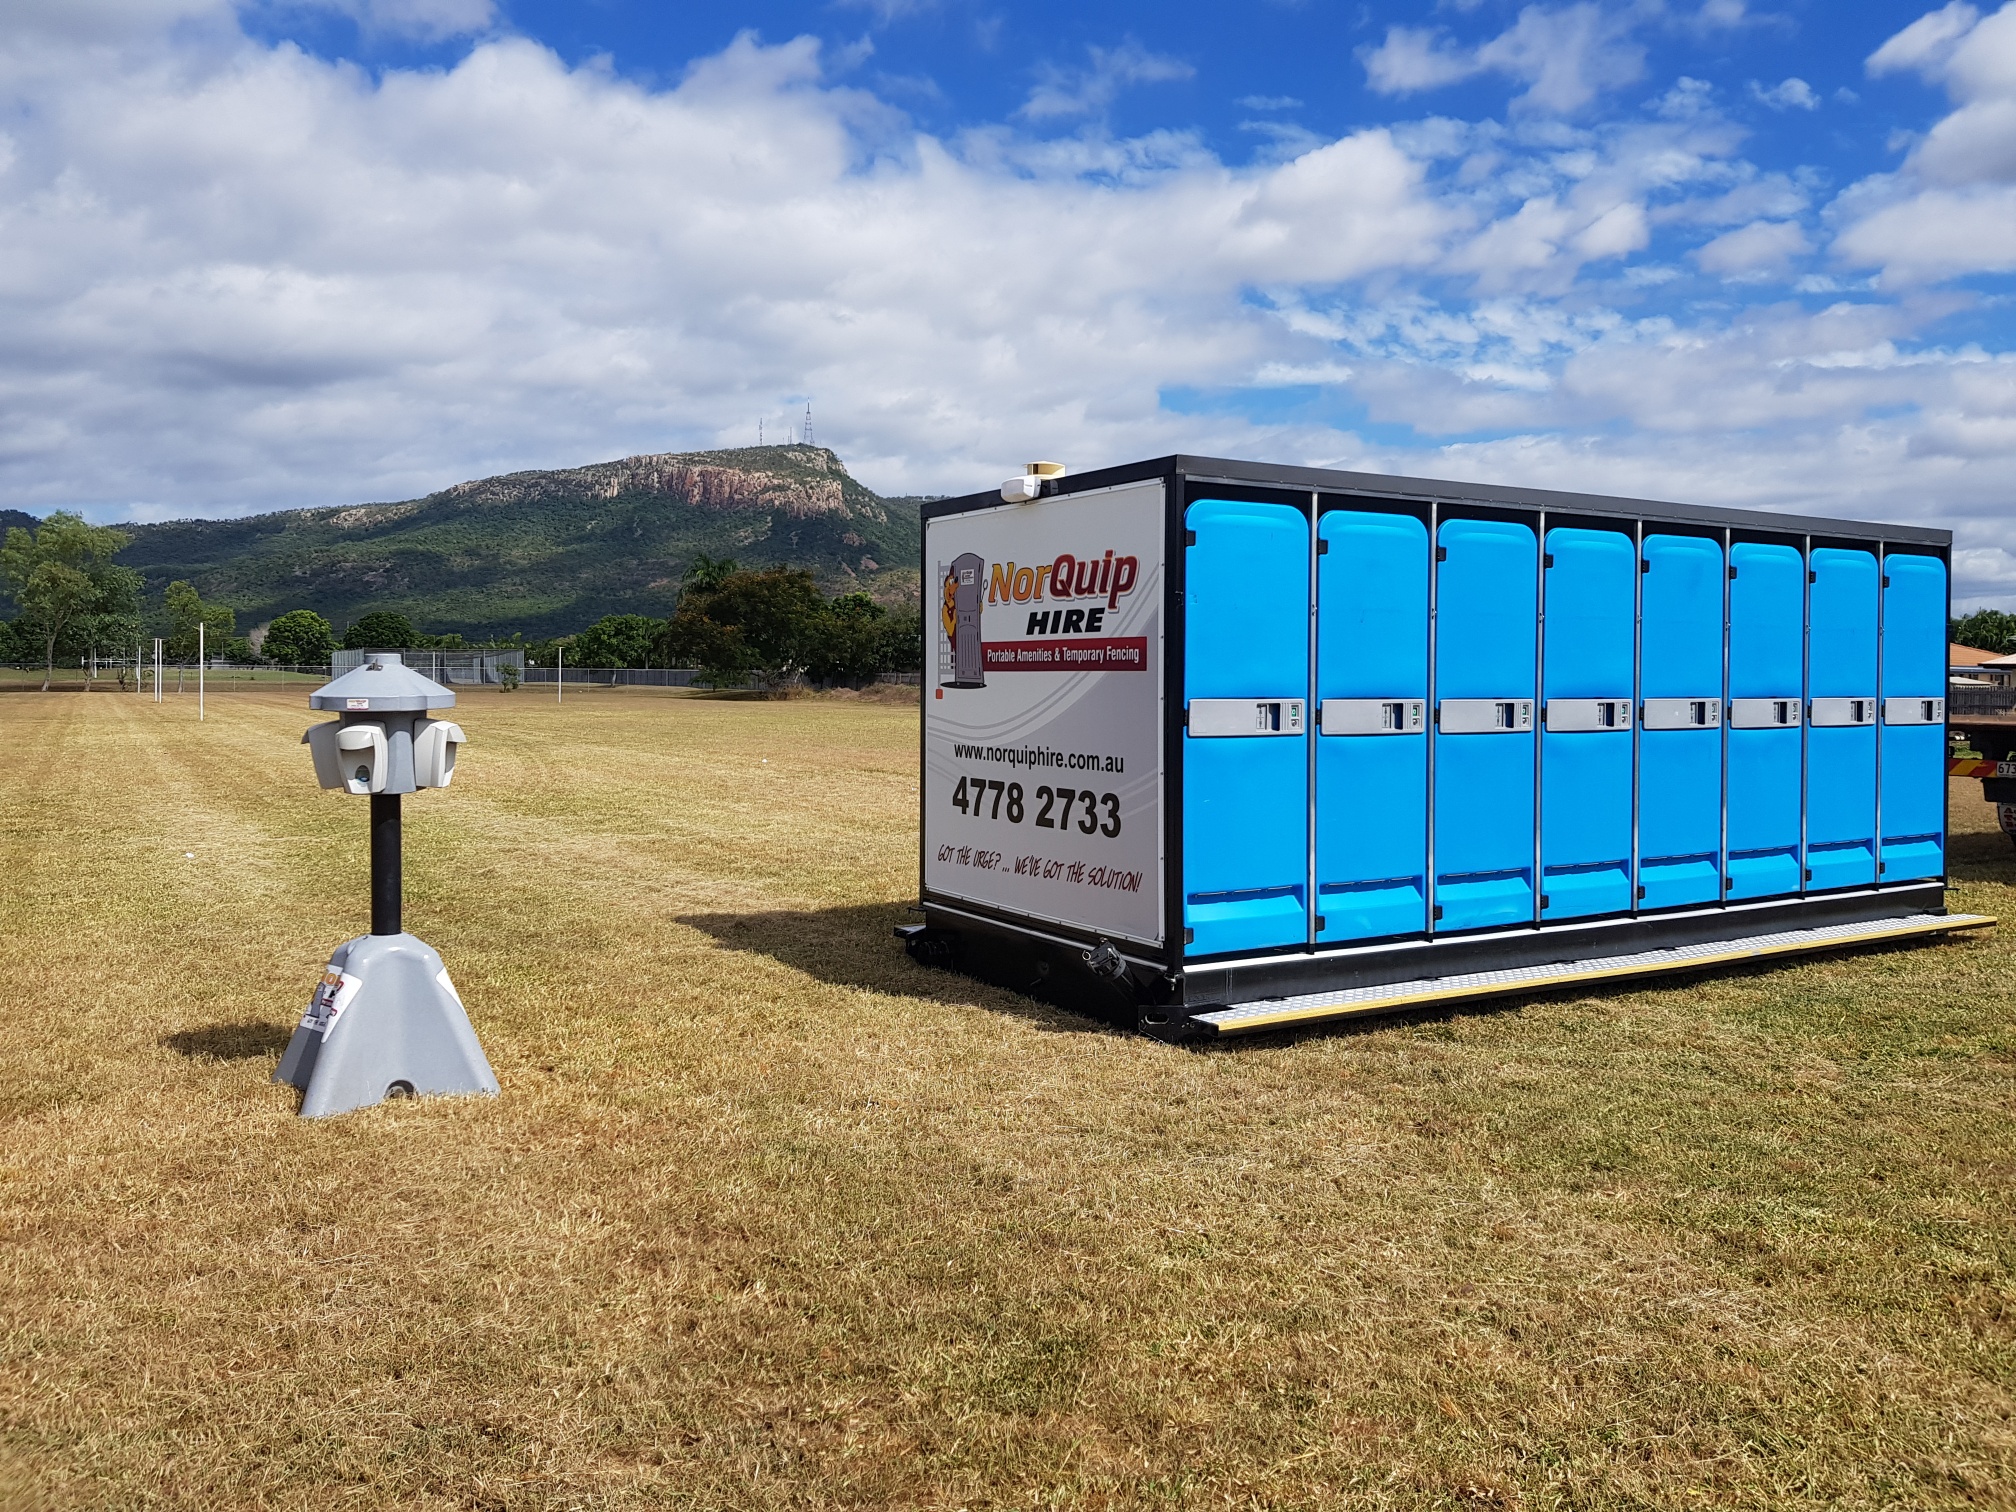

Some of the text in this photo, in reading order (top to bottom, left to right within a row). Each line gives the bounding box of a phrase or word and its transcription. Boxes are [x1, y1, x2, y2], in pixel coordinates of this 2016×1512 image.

[988, 549, 1139, 610] NorQuip
[1025, 607, 1106, 636] HIRE
[987, 645, 1139, 664] Portable Amenities & Temporary Fencing
[954, 744, 1124, 773] www.norquiphire.com.au
[952, 776, 1122, 838] 4778 2733
[938, 844, 955, 863] GOT
[957, 845, 972, 865] THE
[1014, 855, 1042, 877] WE'VE
[1043, 859, 1064, 880] GOT
[1066, 861, 1087, 884] THE
[1088, 865, 1143, 893] SOLUTION!
